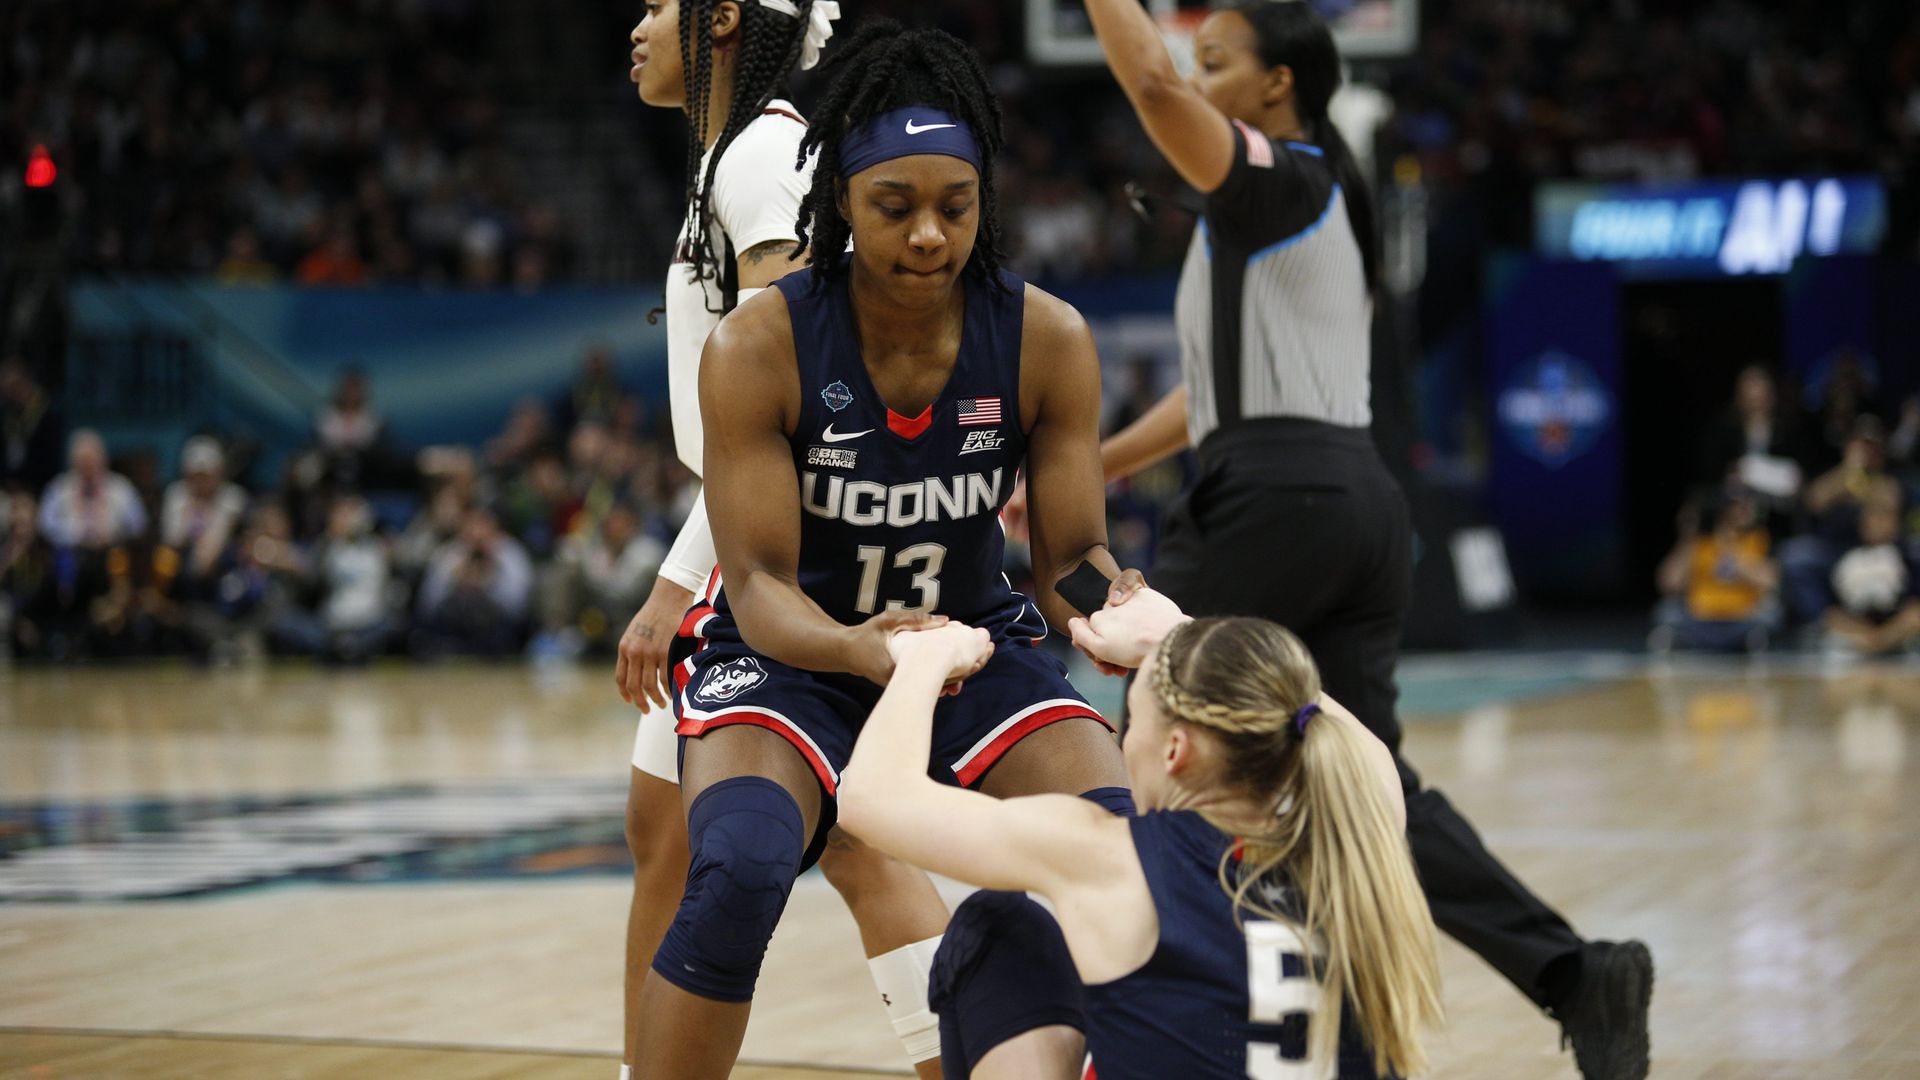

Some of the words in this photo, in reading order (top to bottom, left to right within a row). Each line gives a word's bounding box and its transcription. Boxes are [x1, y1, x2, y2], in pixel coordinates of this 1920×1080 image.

[961, 438, 1005, 450] EAST
[966, 430, 998, 441] BIG
[807, 457, 856, 469] CHANGE
[802, 467, 1003, 528] UCONN
[854, 541, 948, 617] 13
[1244, 920, 1339, 1080] 5
